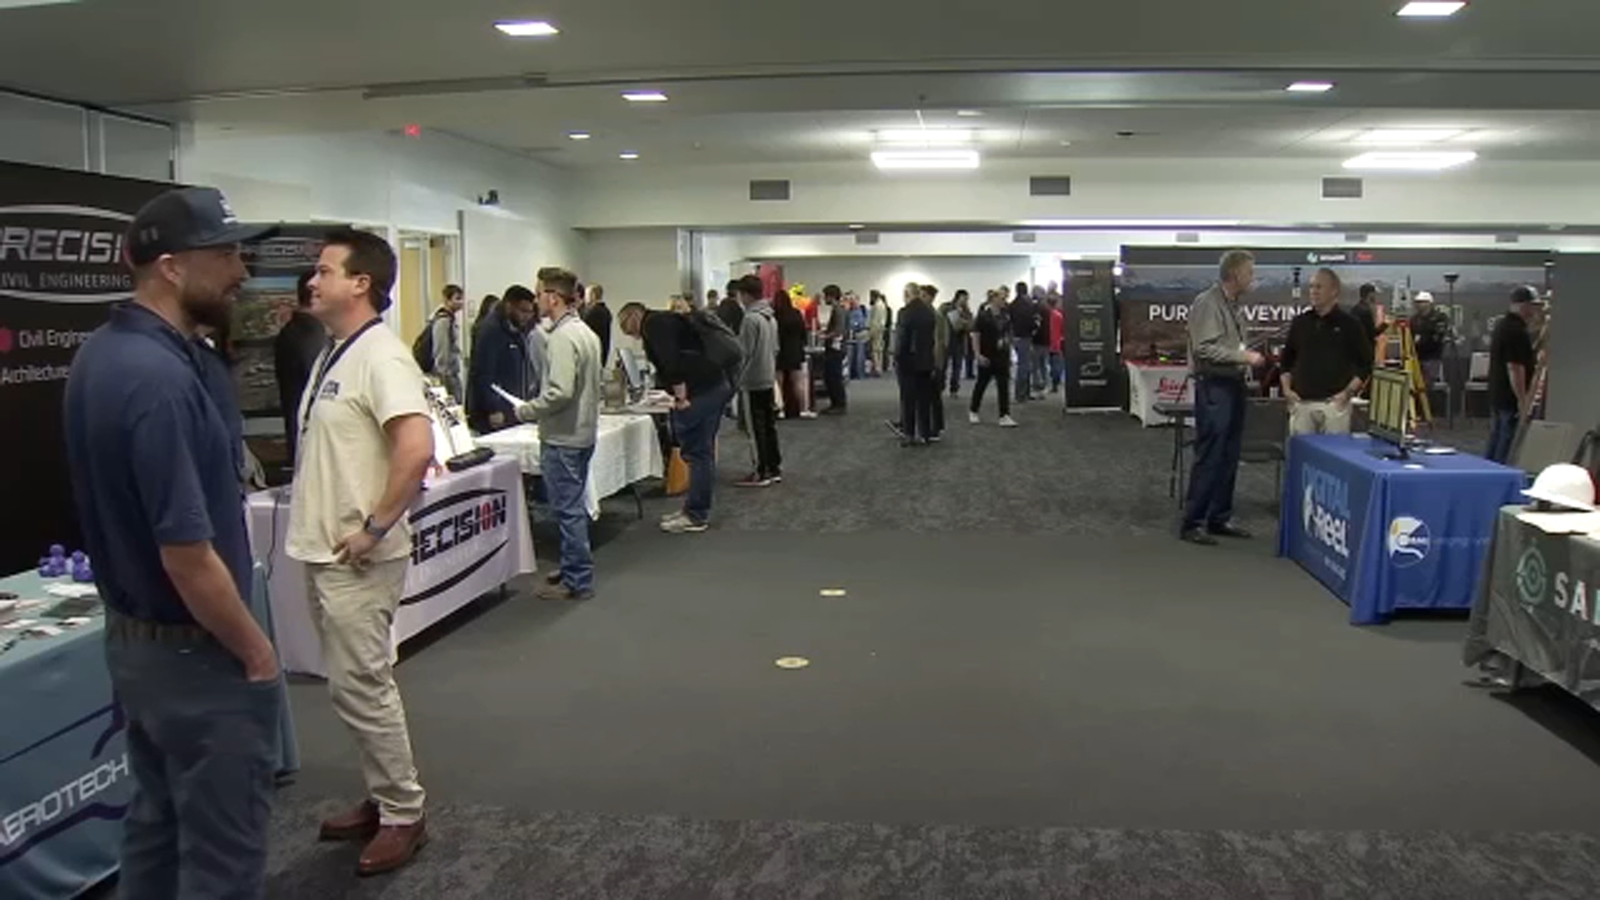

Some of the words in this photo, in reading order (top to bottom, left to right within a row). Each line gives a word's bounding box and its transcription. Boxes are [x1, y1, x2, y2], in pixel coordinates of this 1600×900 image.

[0, 226, 123, 263] RECISI
[0, 271, 32, 289] IVIL
[40, 271, 132, 289] ENGINEERING
[1149, 304, 1192, 321] PUR
[410, 495, 507, 566] ECISION
